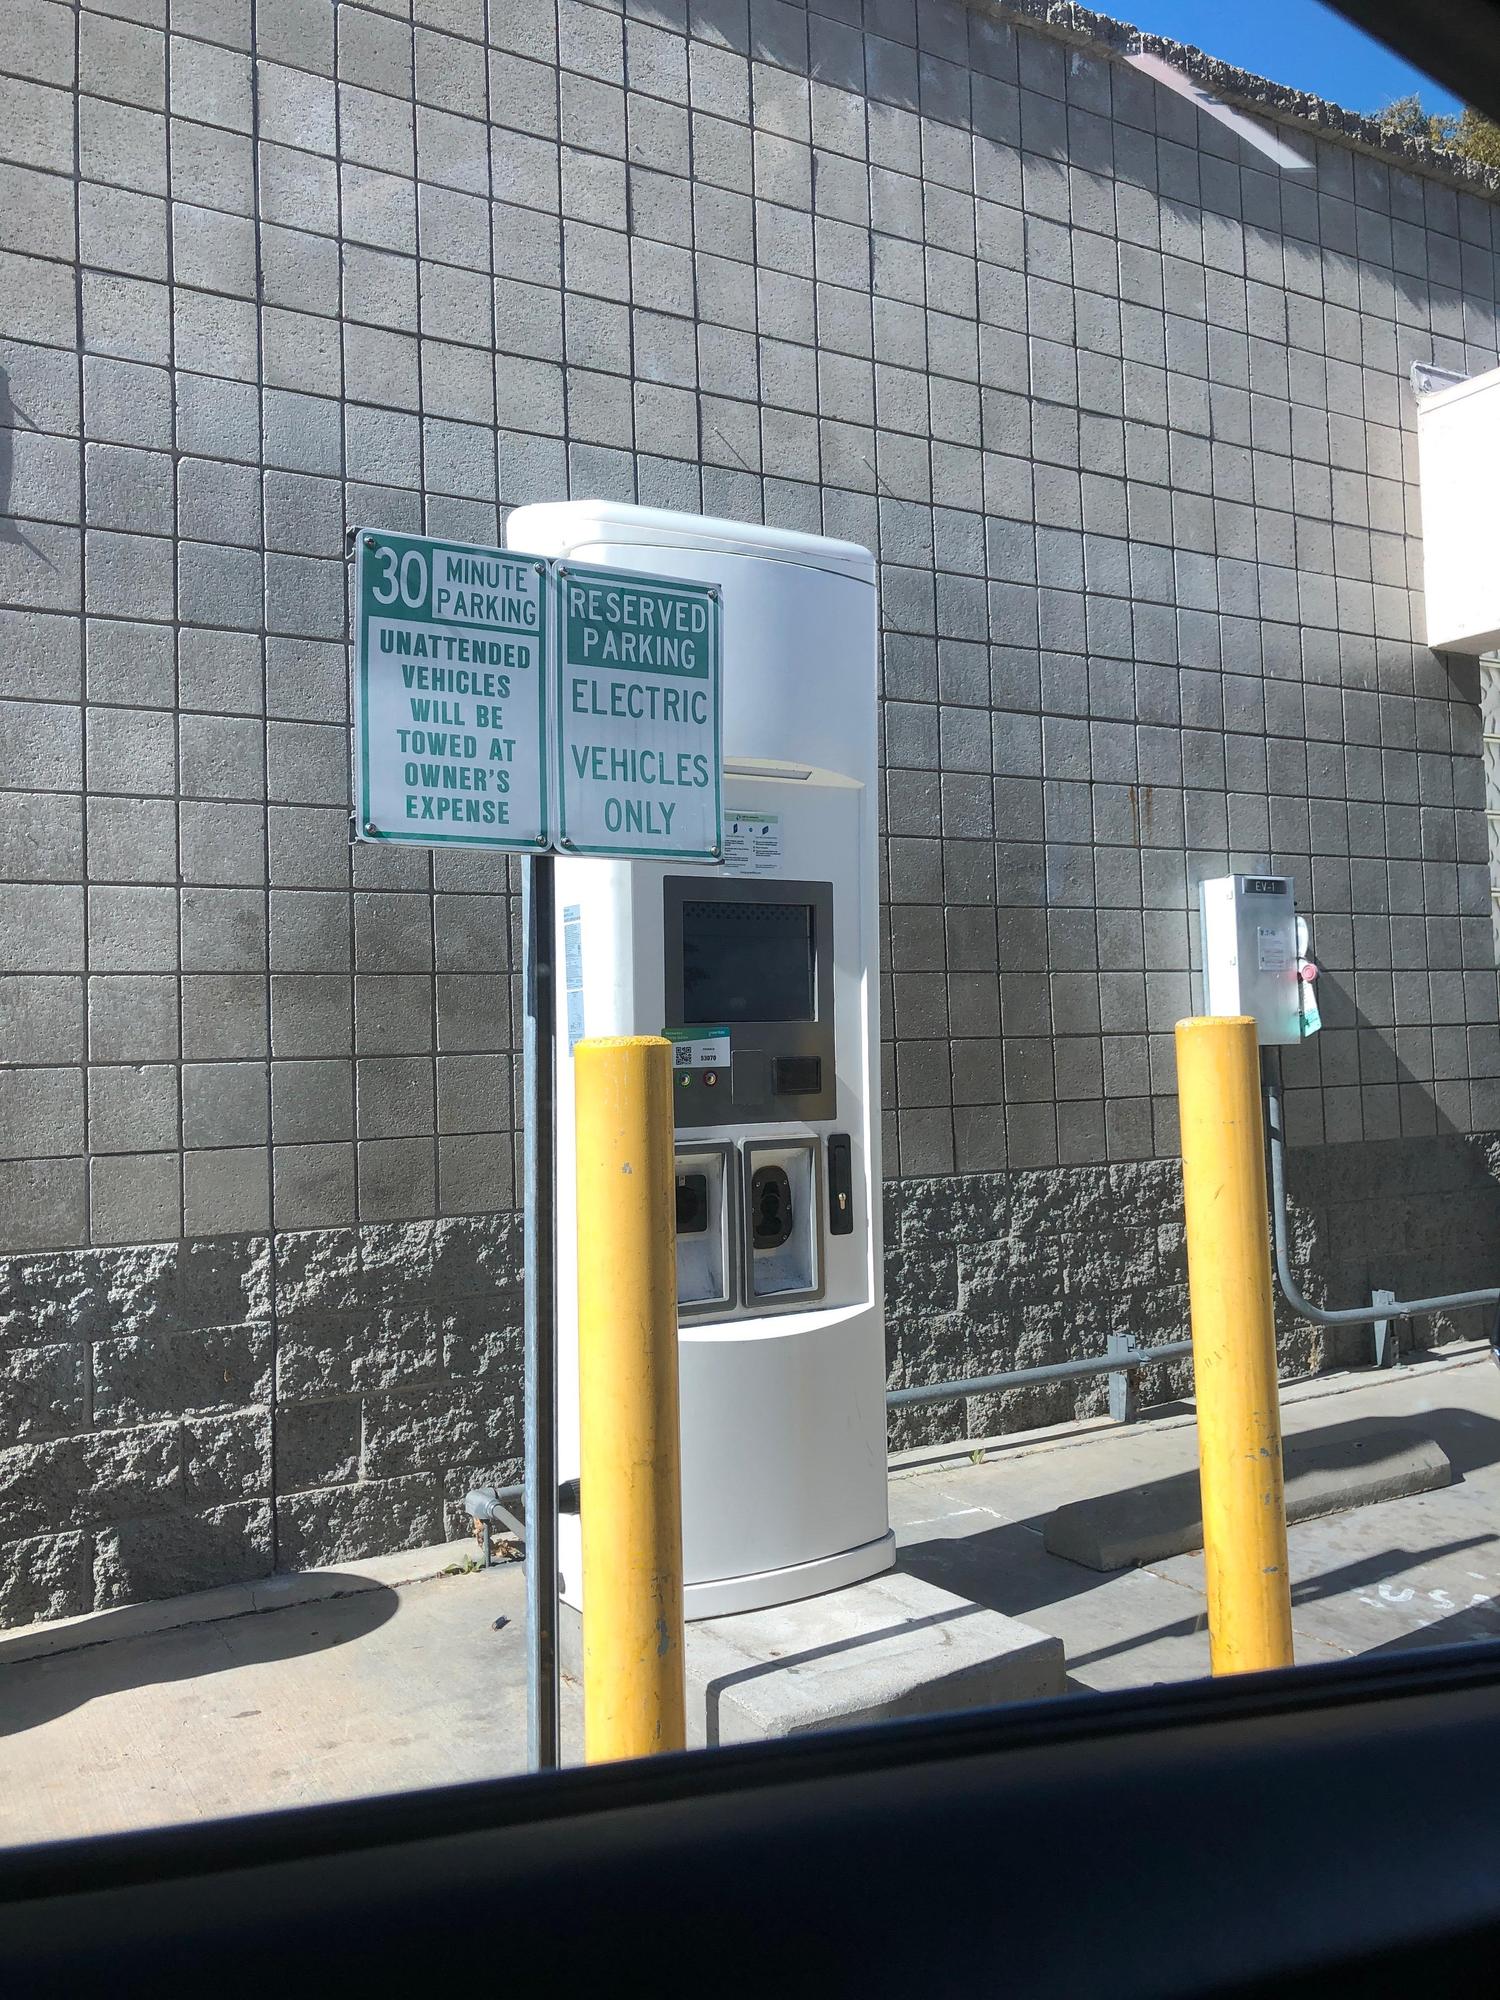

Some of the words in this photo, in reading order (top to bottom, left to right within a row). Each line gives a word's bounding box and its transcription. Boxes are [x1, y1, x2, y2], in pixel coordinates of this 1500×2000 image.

[372, 546, 428, 609] 30
[446, 556, 528, 593] MINUTE
[437, 588, 536, 626] PARKING
[570, 587, 706, 633] RESERVED
[380, 629, 531, 669] UNATTENDED
[583, 627, 696, 670] PARKING
[402, 664, 511, 699] VEHICLES
[410, 697, 465, 726] WILL
[476, 704, 503, 730] BE
[572, 678, 707, 725] ELECTRIC
[396, 729, 477, 759] TOWED
[489, 738, 516, 762] AT
[404, 762, 510, 793] OWNER'S
[570, 744, 709, 788] VEHICLES
[406, 795, 510, 825] EXPENSE
[604, 797, 676, 835] ONLY
[1255, 881, 1275, 892] EV-1
